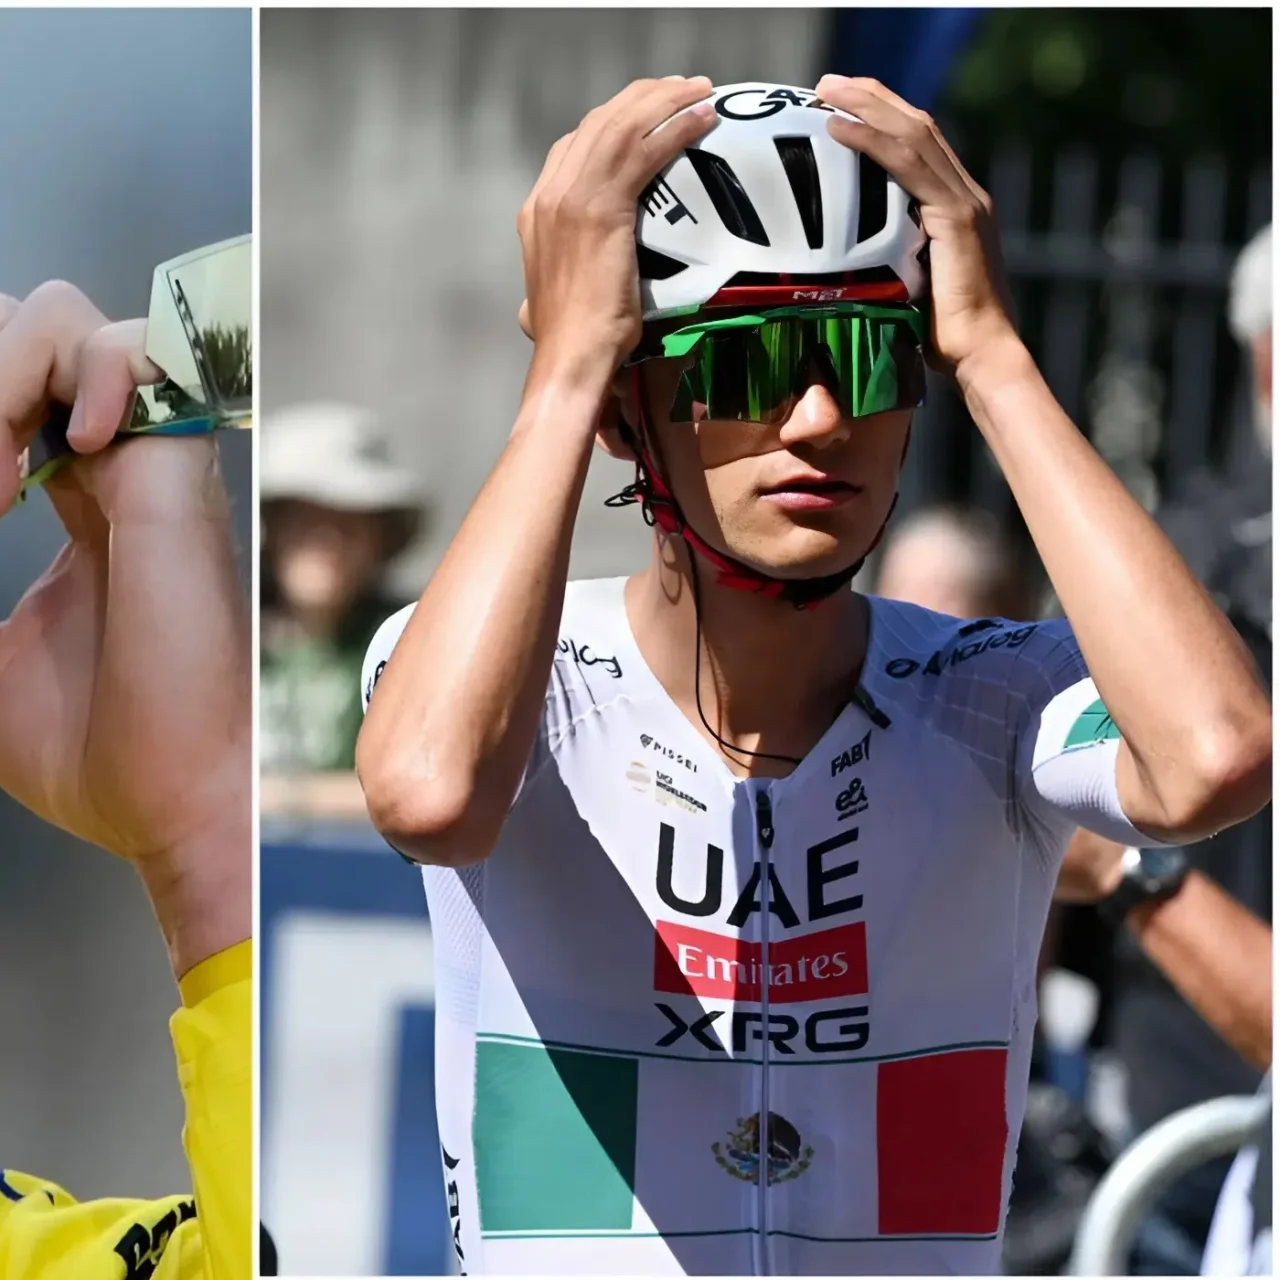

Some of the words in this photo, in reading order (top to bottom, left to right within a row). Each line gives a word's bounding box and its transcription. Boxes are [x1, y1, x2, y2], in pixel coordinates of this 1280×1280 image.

[638, 172, 699, 226] ET
[792, 287, 848, 301] MET
[656, 822, 864, 929] UAE
[676, 942, 849, 988] Emirates
[653, 1002, 870, 1054] XRG
